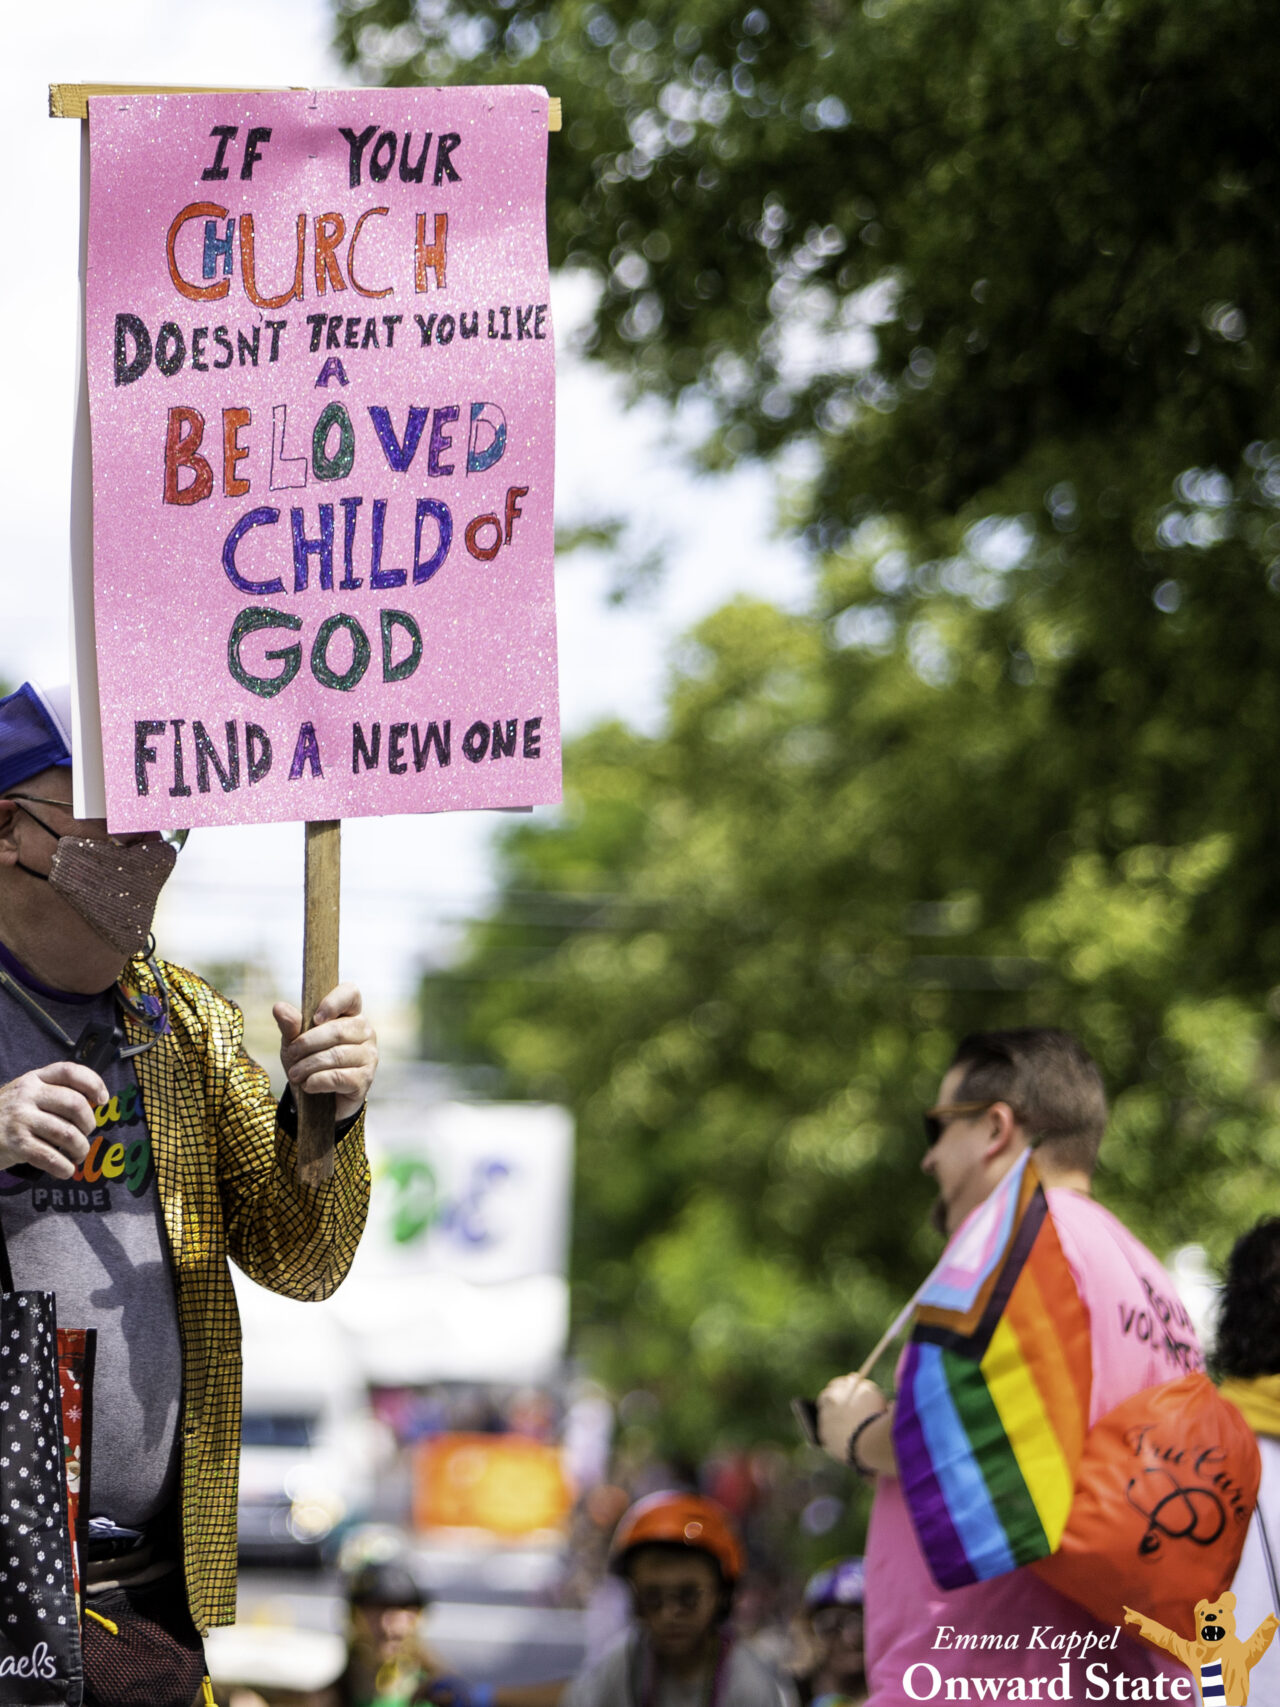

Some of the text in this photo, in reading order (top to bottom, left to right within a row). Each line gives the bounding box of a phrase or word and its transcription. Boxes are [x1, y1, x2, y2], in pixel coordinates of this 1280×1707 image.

[200, 125, 462, 188] IF YOUR
[166, 201, 449, 309] CHURCH
[307, 313, 403, 352] TREAT
[414, 311, 479, 347] YOU
[487, 304, 548, 340] LIKE
[315, 357, 350, 388] A
[163, 401, 508, 505] BELOVED
[222, 486, 530, 595] CHILD OF
[227, 606, 424, 699] GOD
[134, 717, 543, 797] FIND A NEW ONE
[34, 1187, 106, 1207] PRIDE
